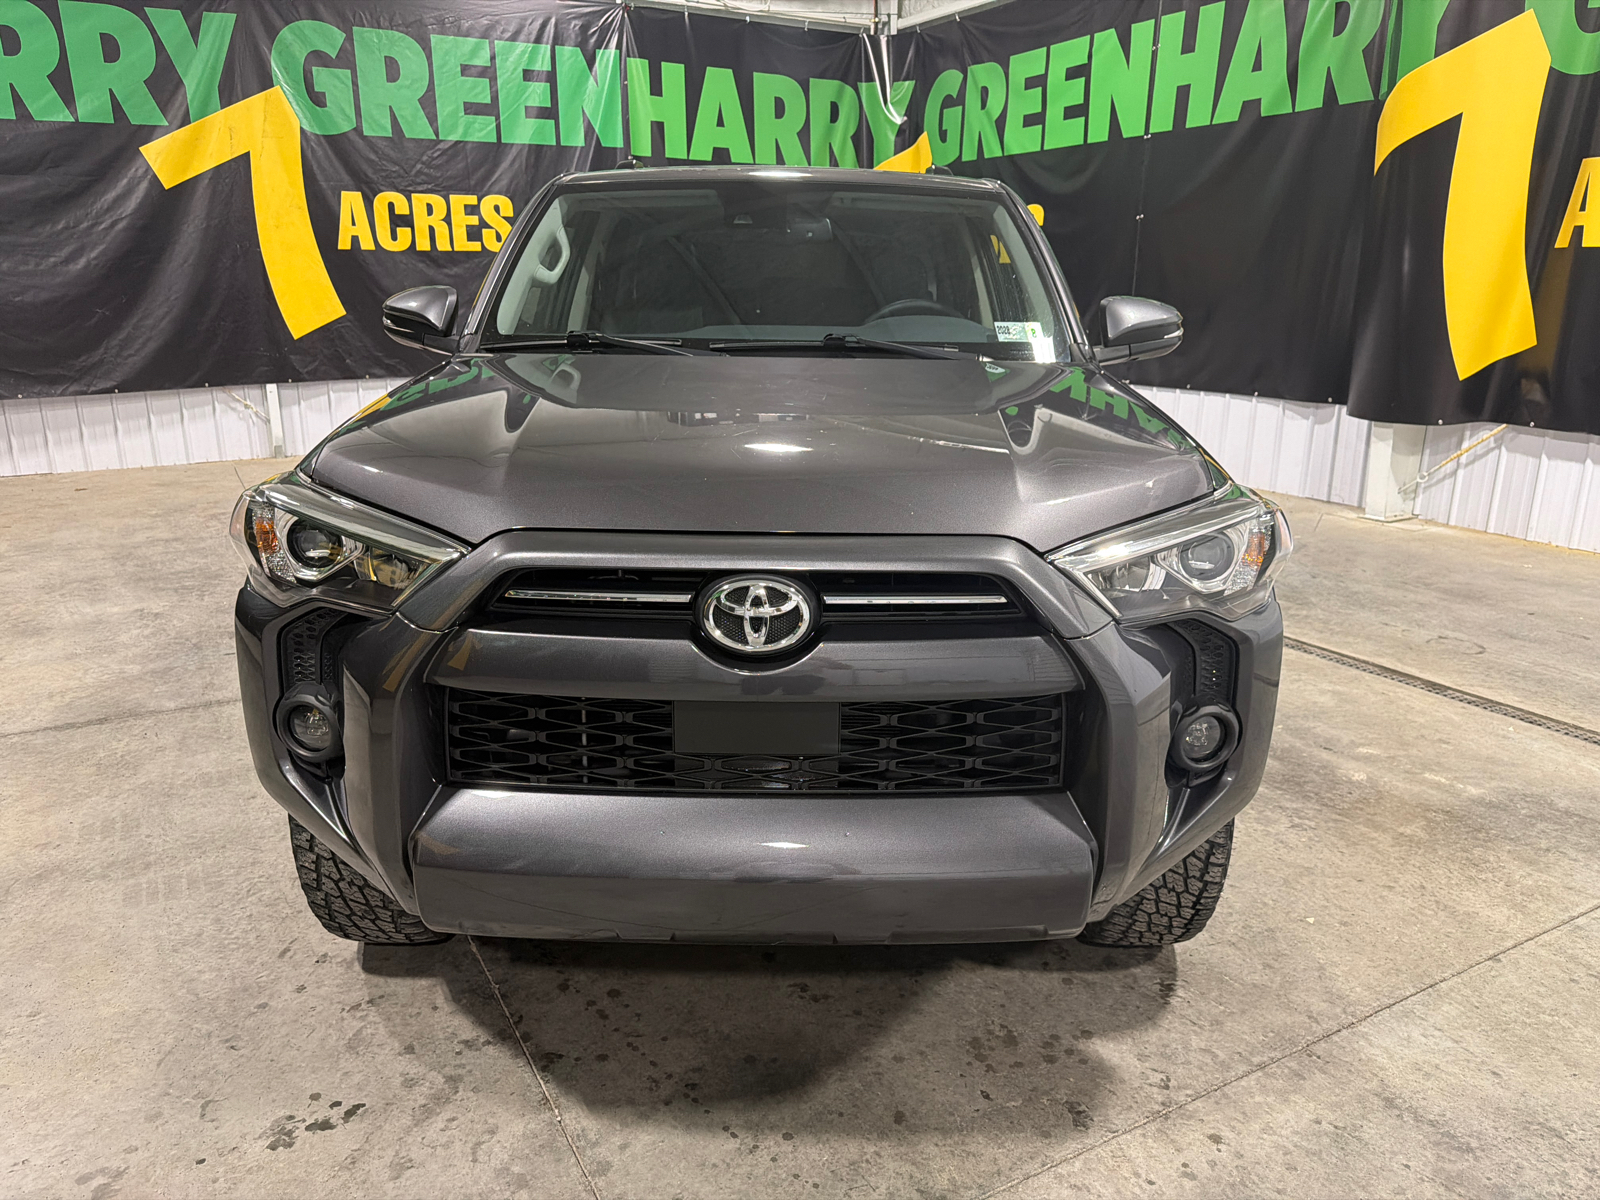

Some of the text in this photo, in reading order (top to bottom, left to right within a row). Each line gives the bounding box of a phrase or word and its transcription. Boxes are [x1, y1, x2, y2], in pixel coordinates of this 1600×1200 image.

[271, 20, 624, 148] GREEN
[626, 18, 1155, 169] HARRY GREEN
[138, 85, 346, 340] 7
[337, 190, 514, 252] ACRES
[1374, 8, 1551, 380] 7
